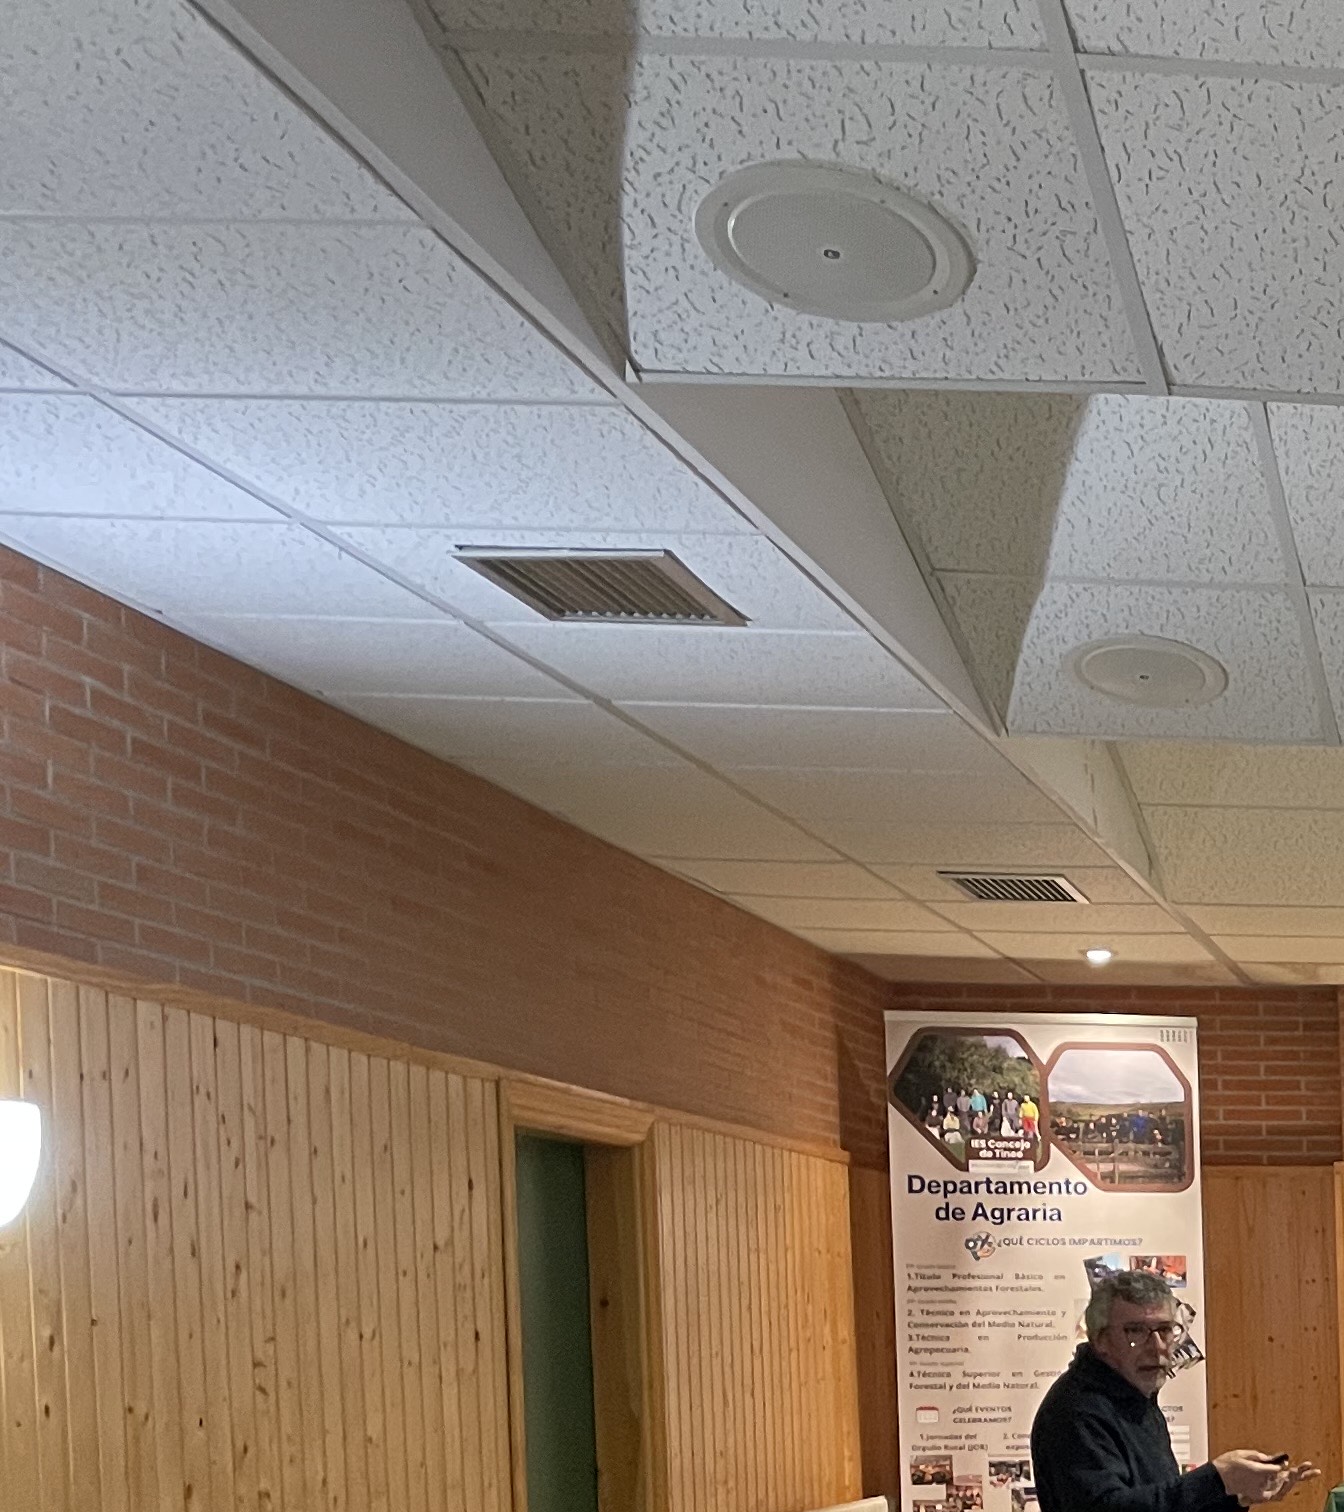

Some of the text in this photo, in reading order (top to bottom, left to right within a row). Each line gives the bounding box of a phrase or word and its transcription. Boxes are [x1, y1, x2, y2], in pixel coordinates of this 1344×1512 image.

[907, 1174, 1088, 1198] Departamento
[935, 1202, 1062, 1225] de Agraria
[1027, 1237, 1066, 1246] CICLOS
